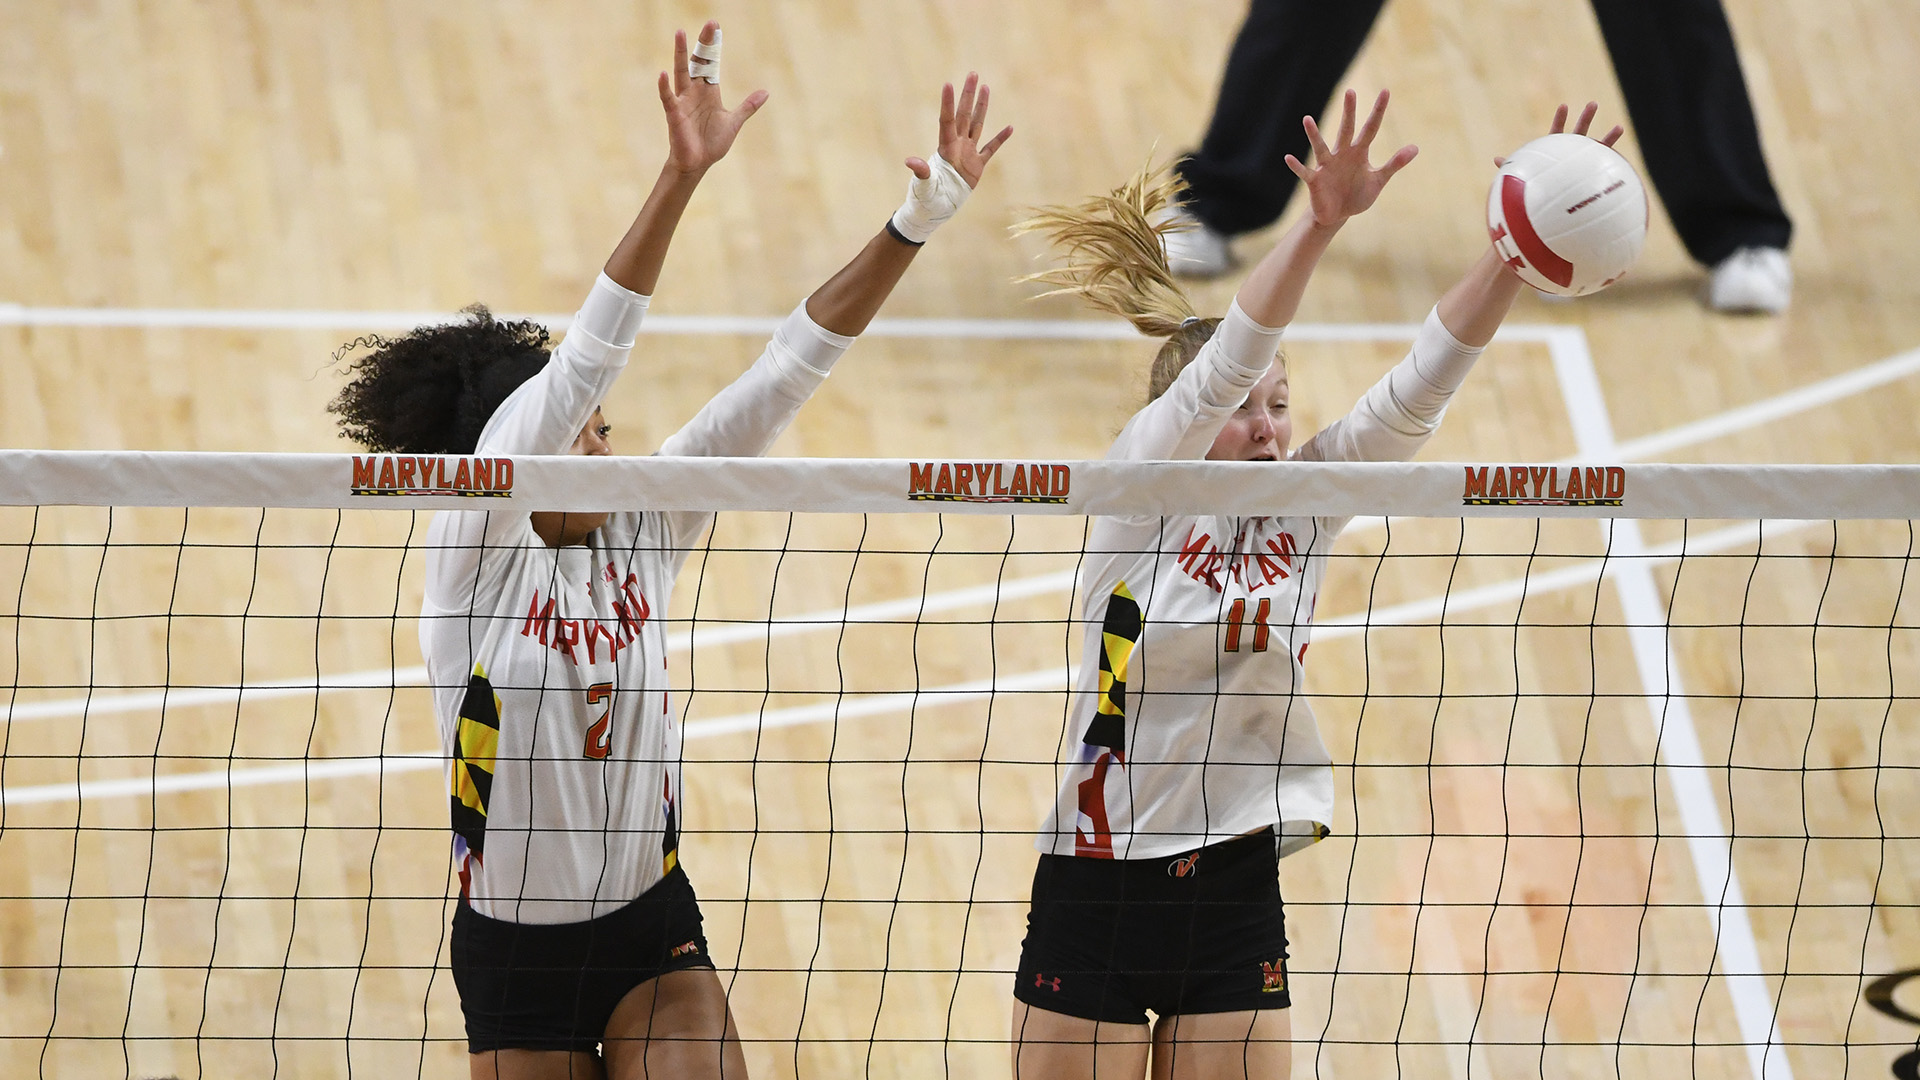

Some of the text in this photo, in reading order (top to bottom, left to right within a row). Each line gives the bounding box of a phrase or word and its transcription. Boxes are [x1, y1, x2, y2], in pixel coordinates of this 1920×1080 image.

[351, 456, 514, 491] MARYLAND
[908, 462, 1071, 497] MARYLAND
[1463, 466, 1626, 499] MARYLAND
[521, 573, 650, 666] MARYLND
[1224, 598, 1271, 652] 11
[583, 682, 613, 760] 2
[1259, 958, 1284, 988] M
